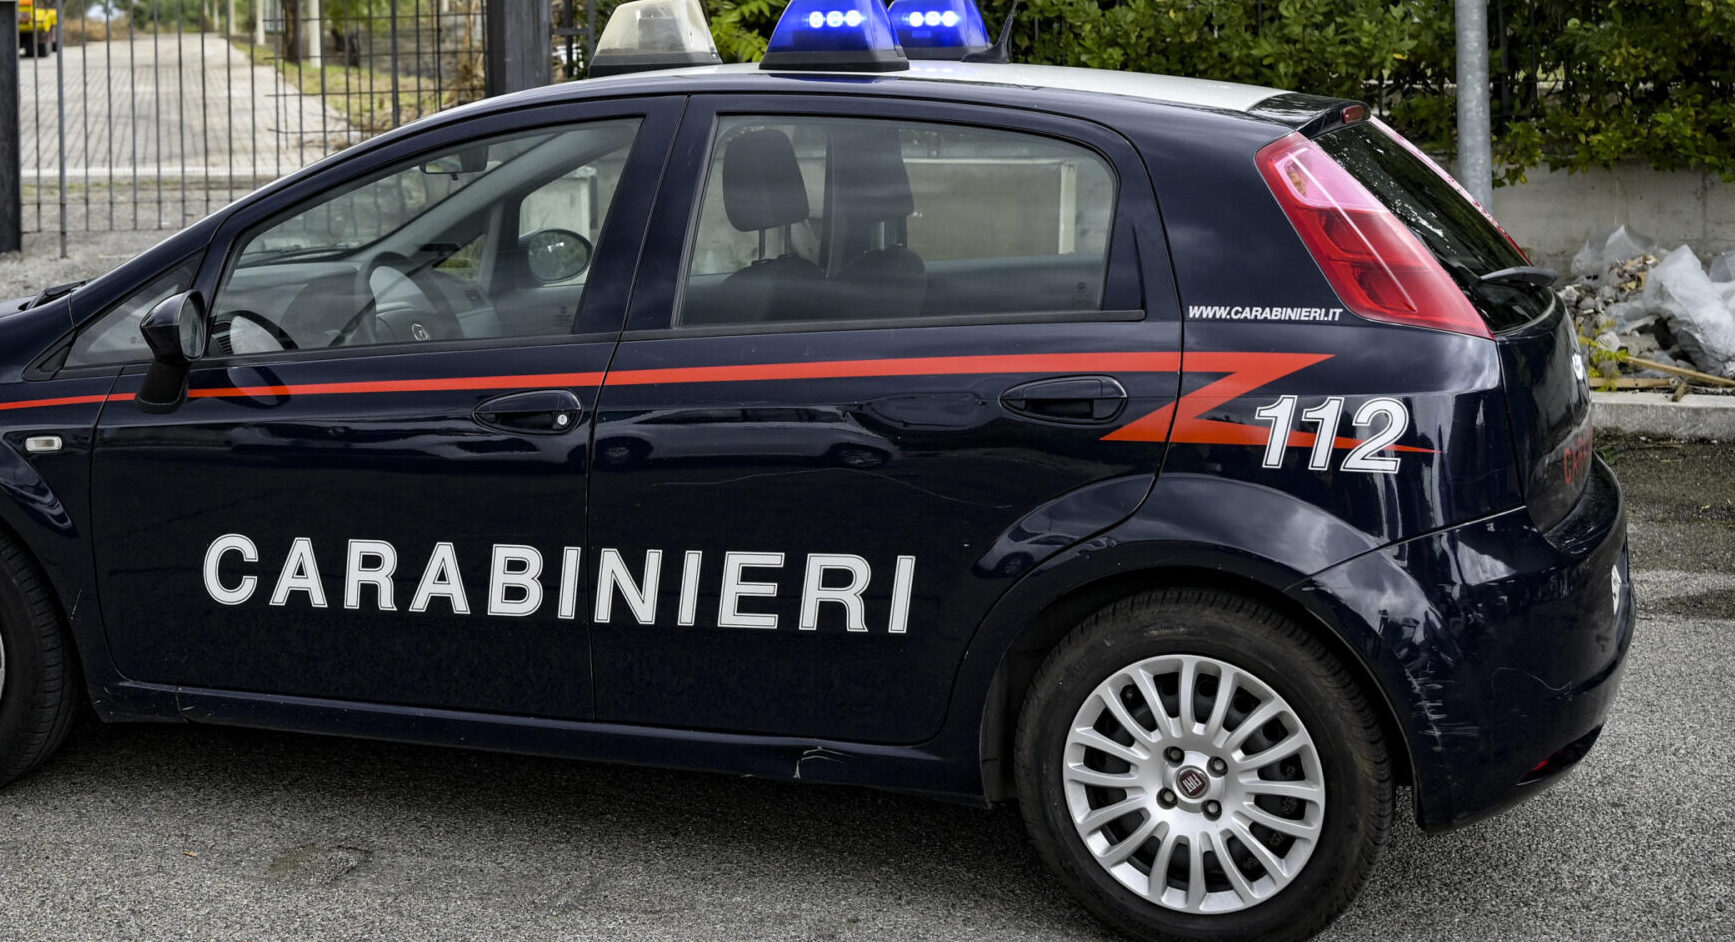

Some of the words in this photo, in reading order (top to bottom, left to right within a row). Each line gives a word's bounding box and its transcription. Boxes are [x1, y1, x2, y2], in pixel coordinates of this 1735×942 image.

[1188, 305, 1343, 321] WWW.CARABINIERI.IT
[1254, 395, 1409, 474] 112
[203, 533, 916, 634] CARABINIERI
[1182, 773, 1203, 793] FIAT
